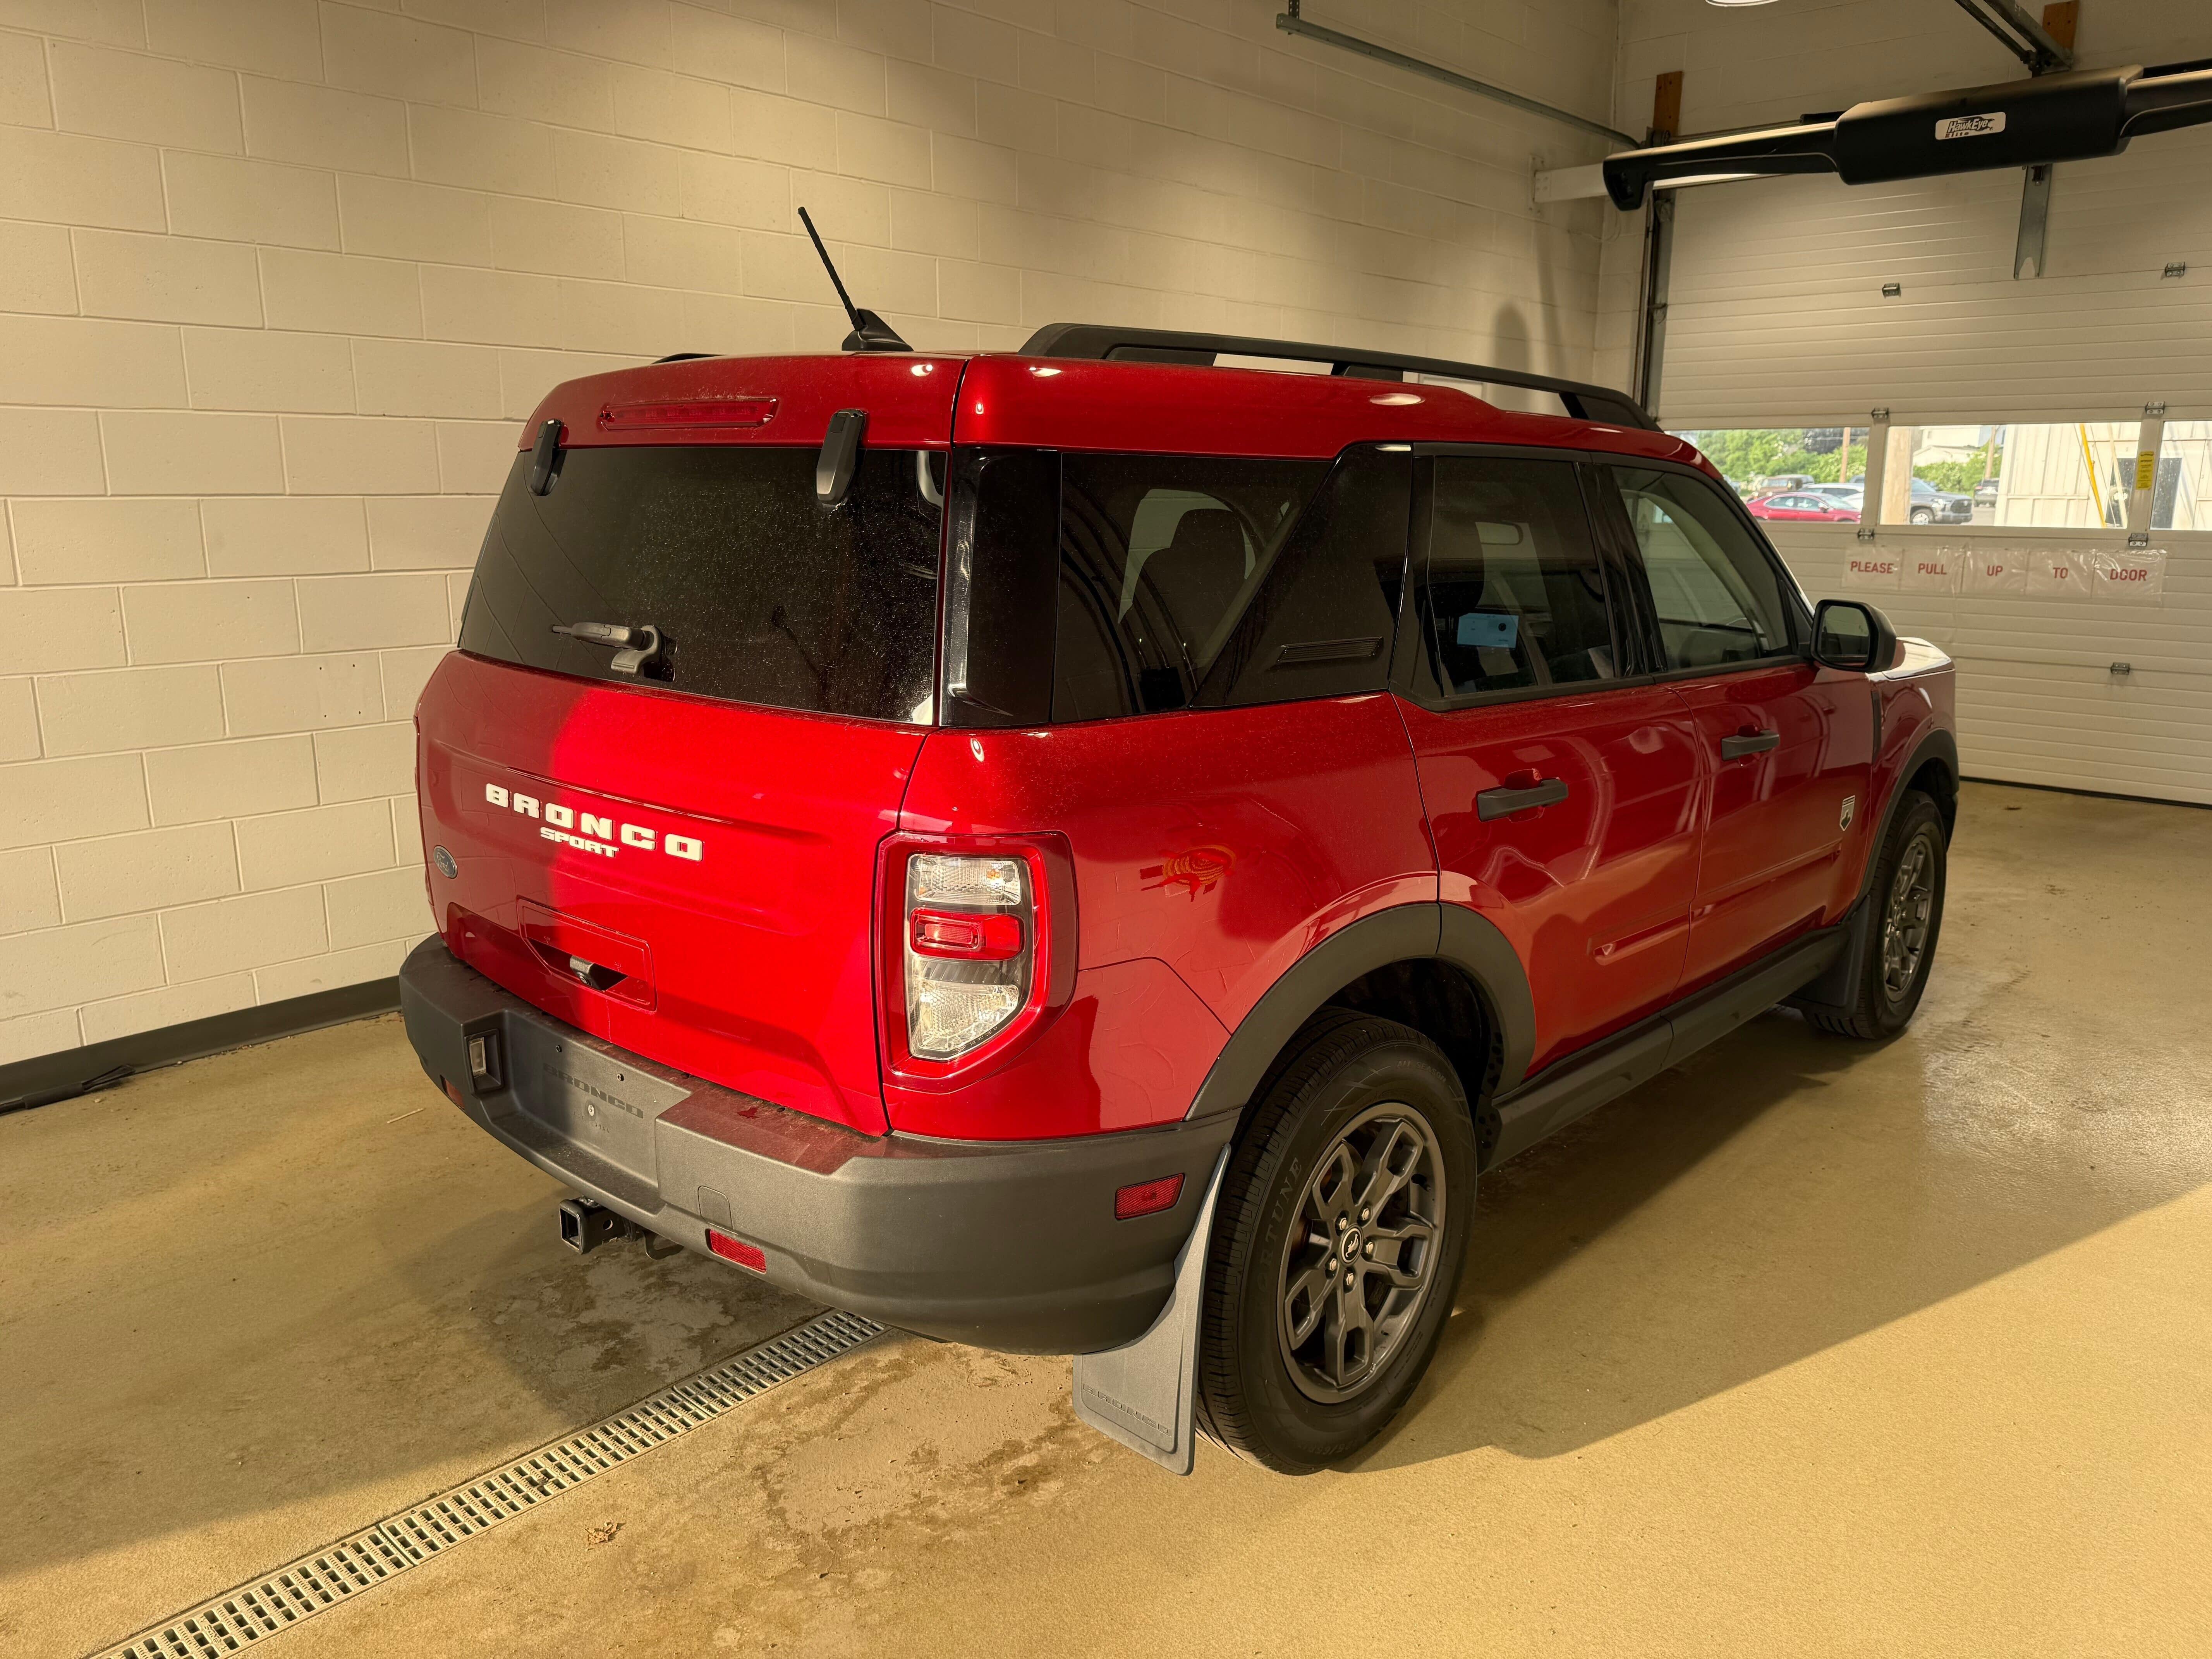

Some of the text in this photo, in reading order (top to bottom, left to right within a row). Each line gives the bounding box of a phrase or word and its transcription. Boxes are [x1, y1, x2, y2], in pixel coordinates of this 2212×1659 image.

[1948, 118, 1988, 132] HawkEye
[1850, 561, 2147, 582] PLEASE PULL UP TO DOOR
[486, 783, 704, 862] BRONCO
[540, 827, 620, 858] SPORT
[1415, 1061, 1447, 1084] SEASON
[543, 1062, 643, 1119] BRONCO
[1083, 1383, 1172, 1437] BRONCO
